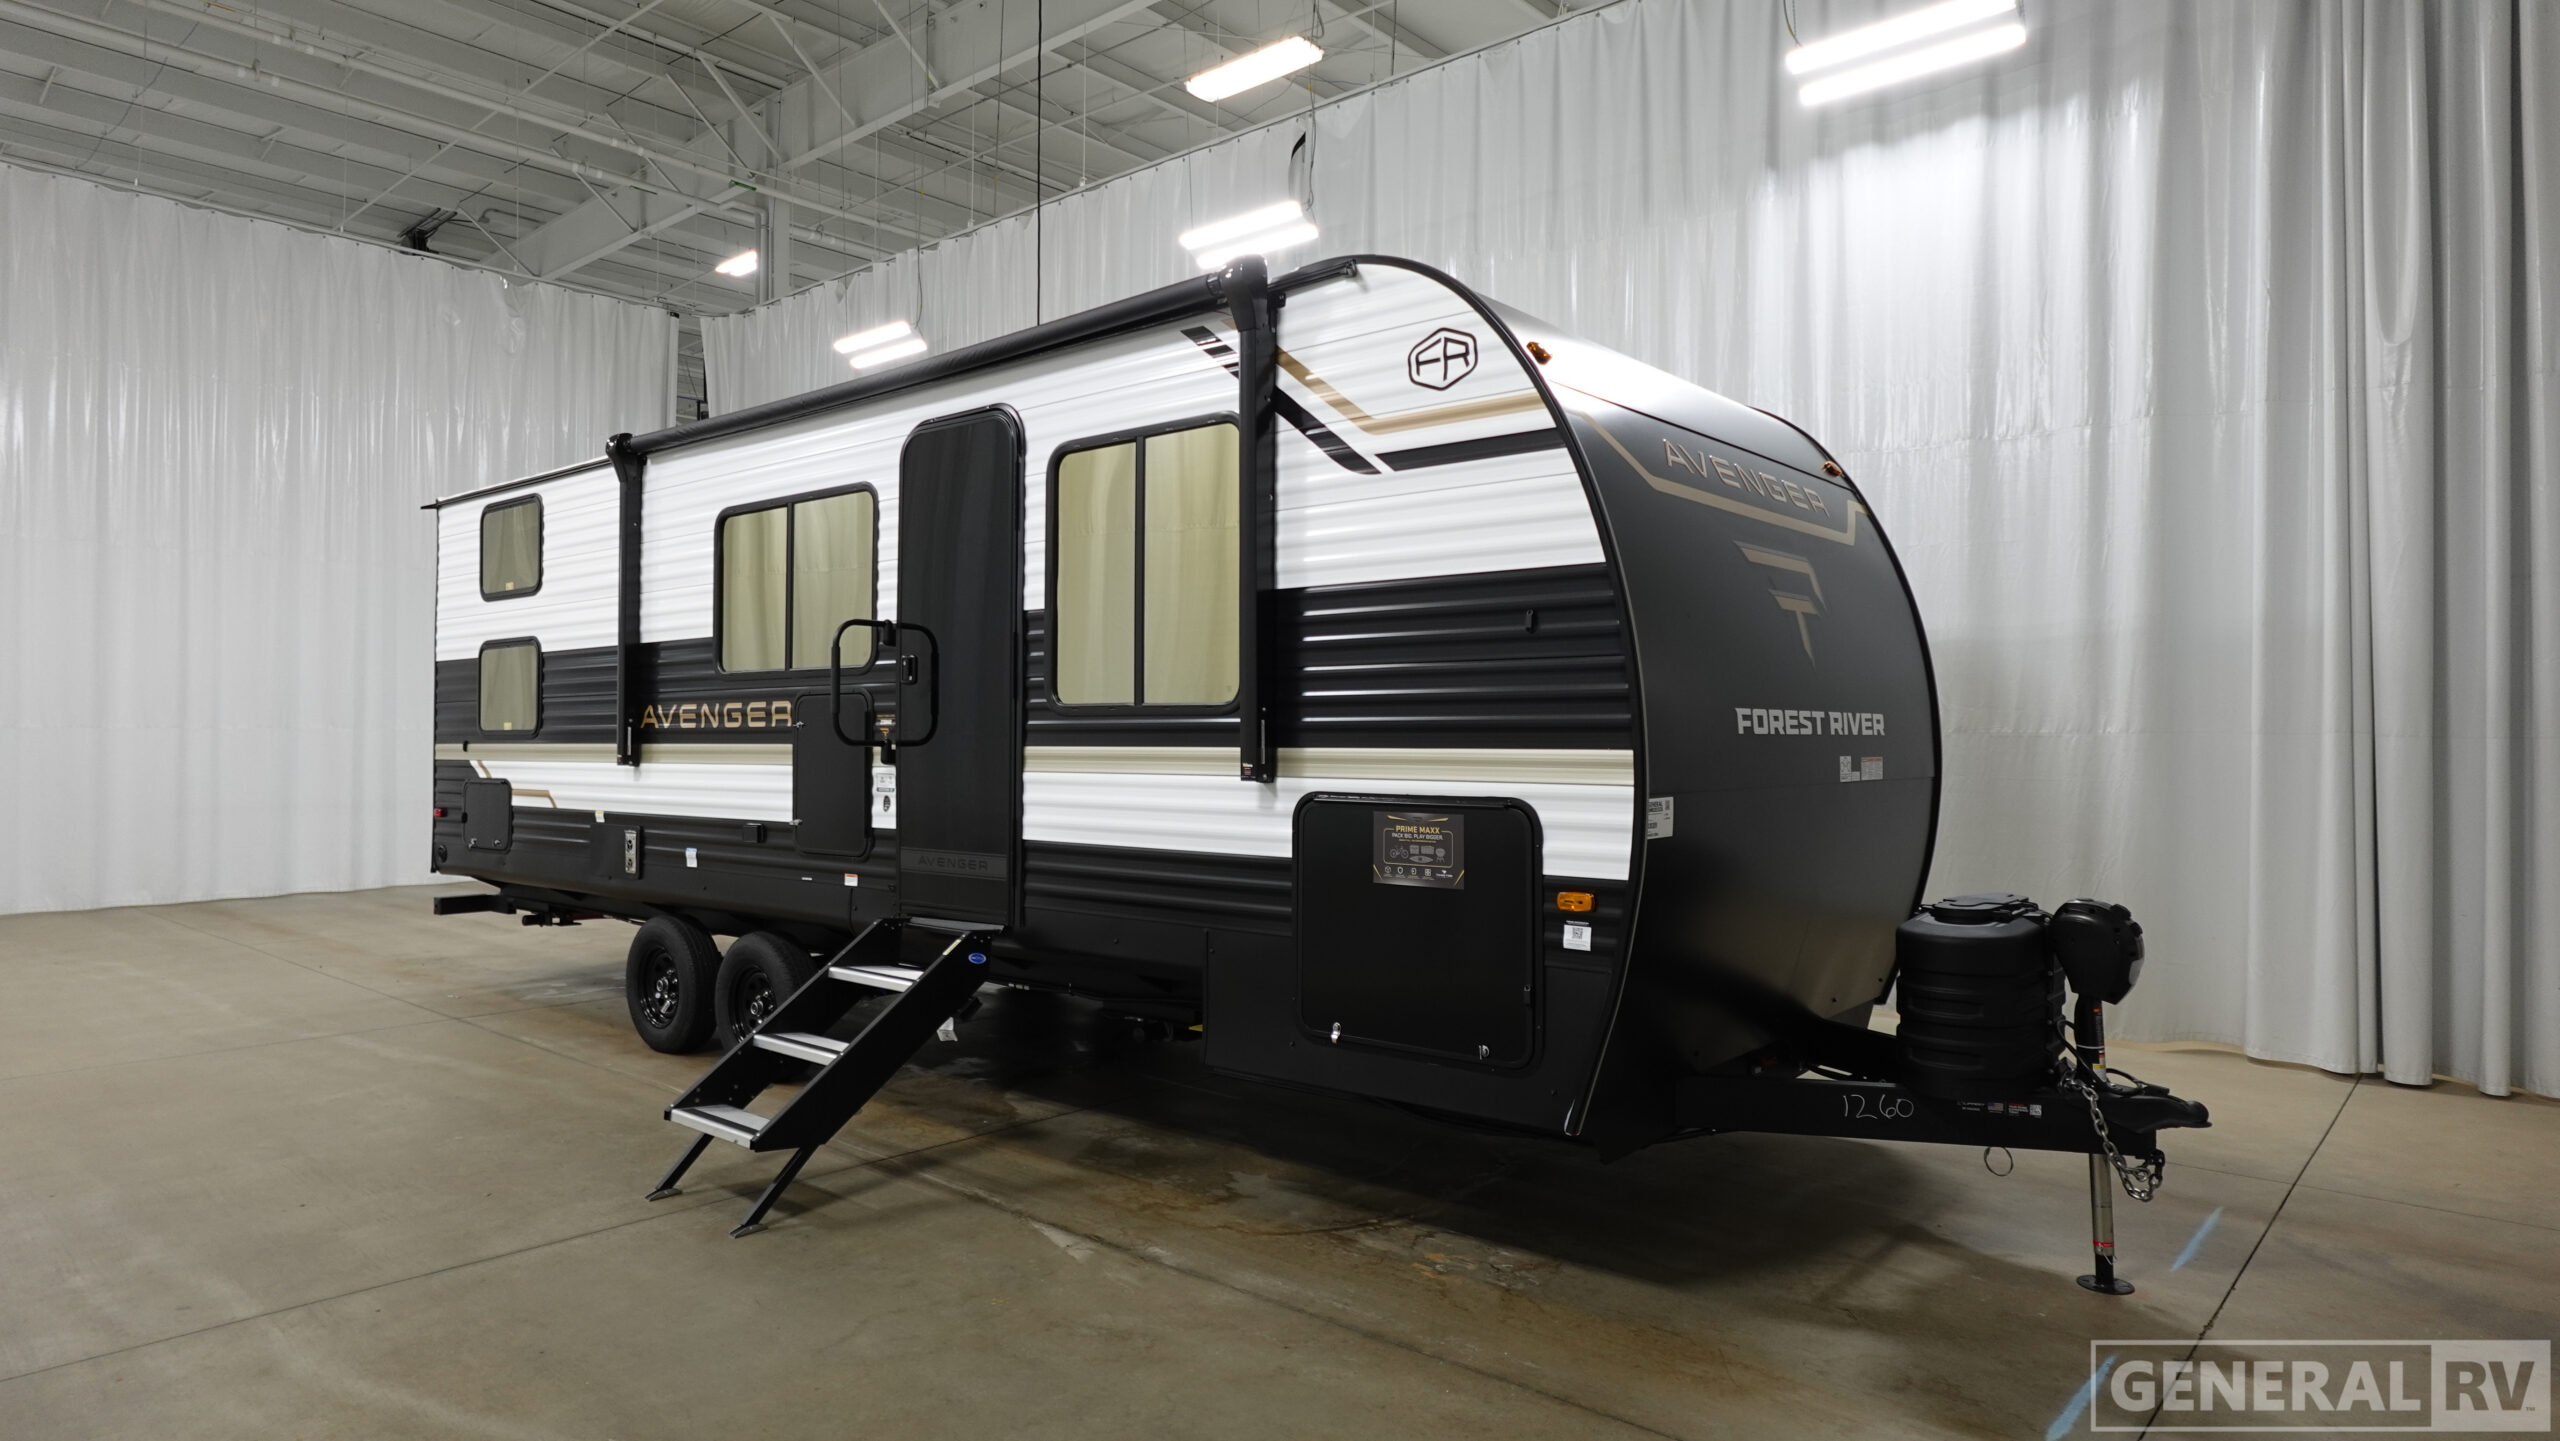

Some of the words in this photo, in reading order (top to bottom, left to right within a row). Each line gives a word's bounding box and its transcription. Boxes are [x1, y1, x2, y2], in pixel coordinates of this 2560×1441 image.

[1663, 438, 1831, 519] AVENGER
[640, 700, 792, 729] AVENGER
[1735, 707, 1825, 736] FOREST
[1828, 711, 1886, 736] RIVER
[1419, 826, 1440, 834] MAXX
[917, 855, 989, 872] AVENGER
[1842, 1094, 1914, 1120] 1260
